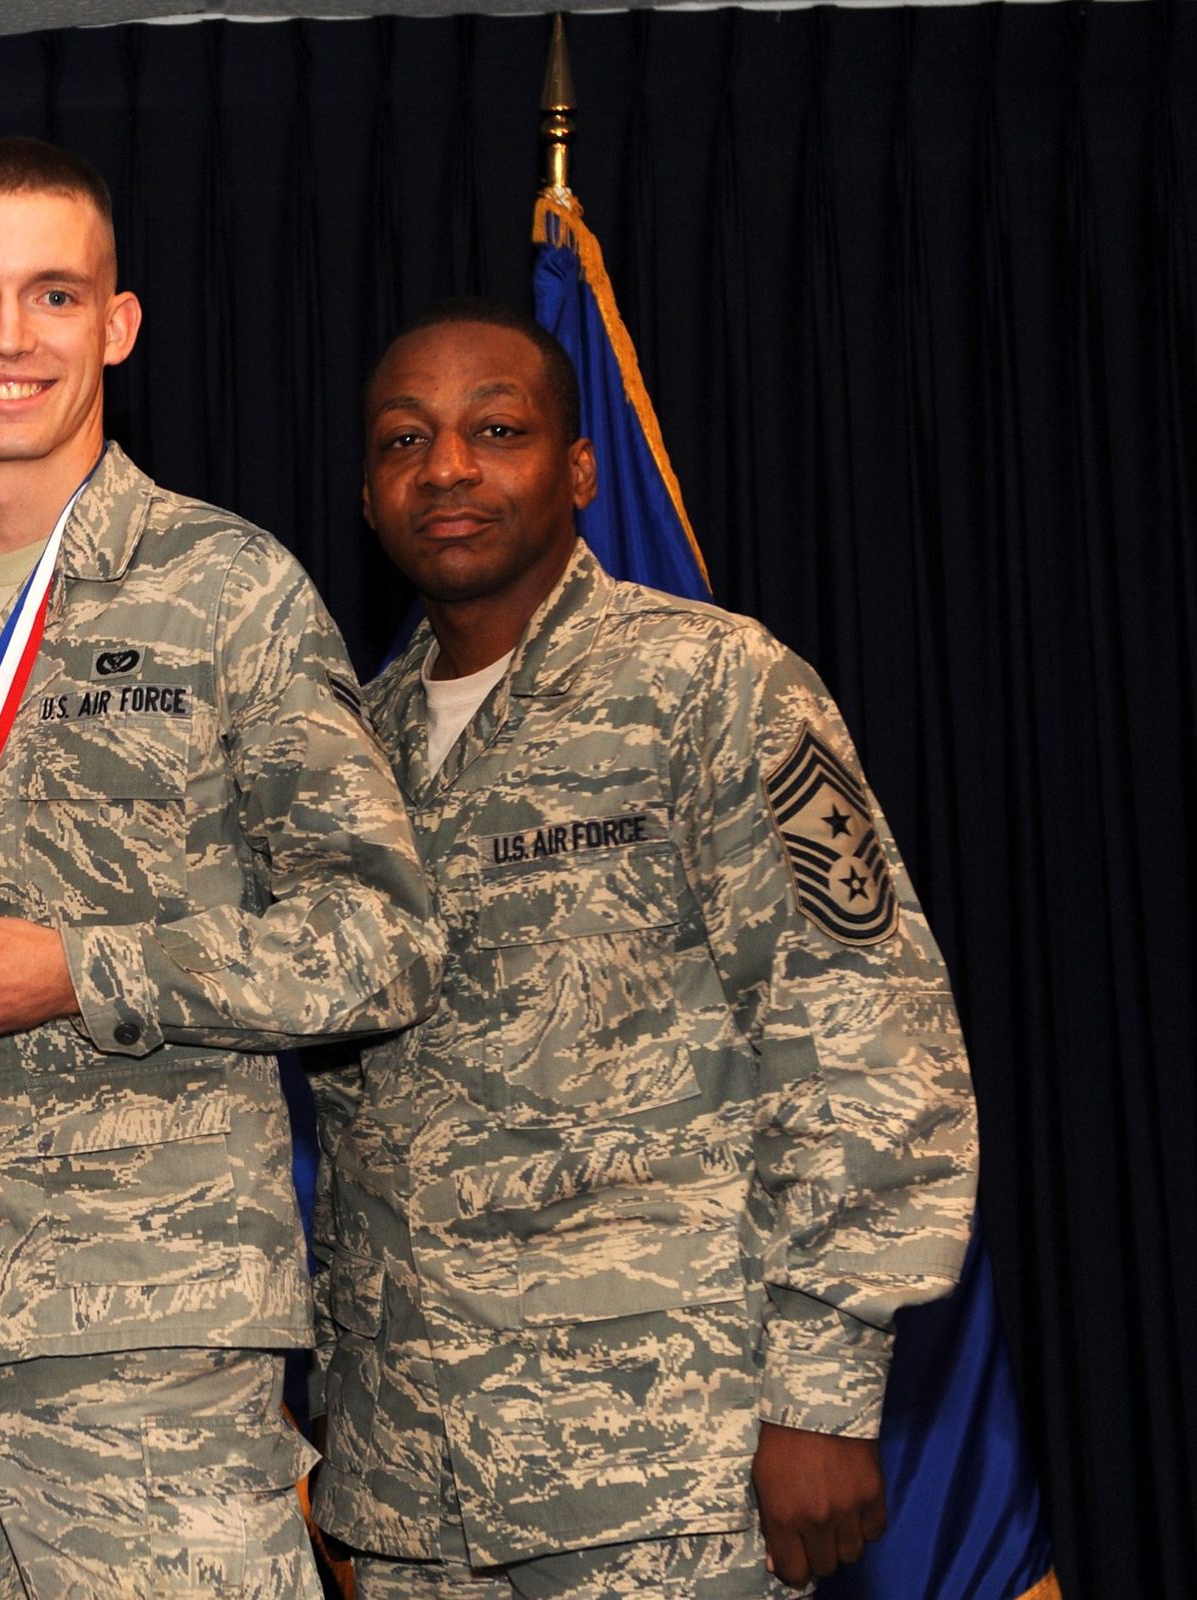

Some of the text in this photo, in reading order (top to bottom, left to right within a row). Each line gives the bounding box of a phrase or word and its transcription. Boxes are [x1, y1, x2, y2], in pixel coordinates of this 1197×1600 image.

[41, 687, 187, 721] U.S. AIR FORCE
[493, 815, 648, 864] U.S. AIR FORCE
